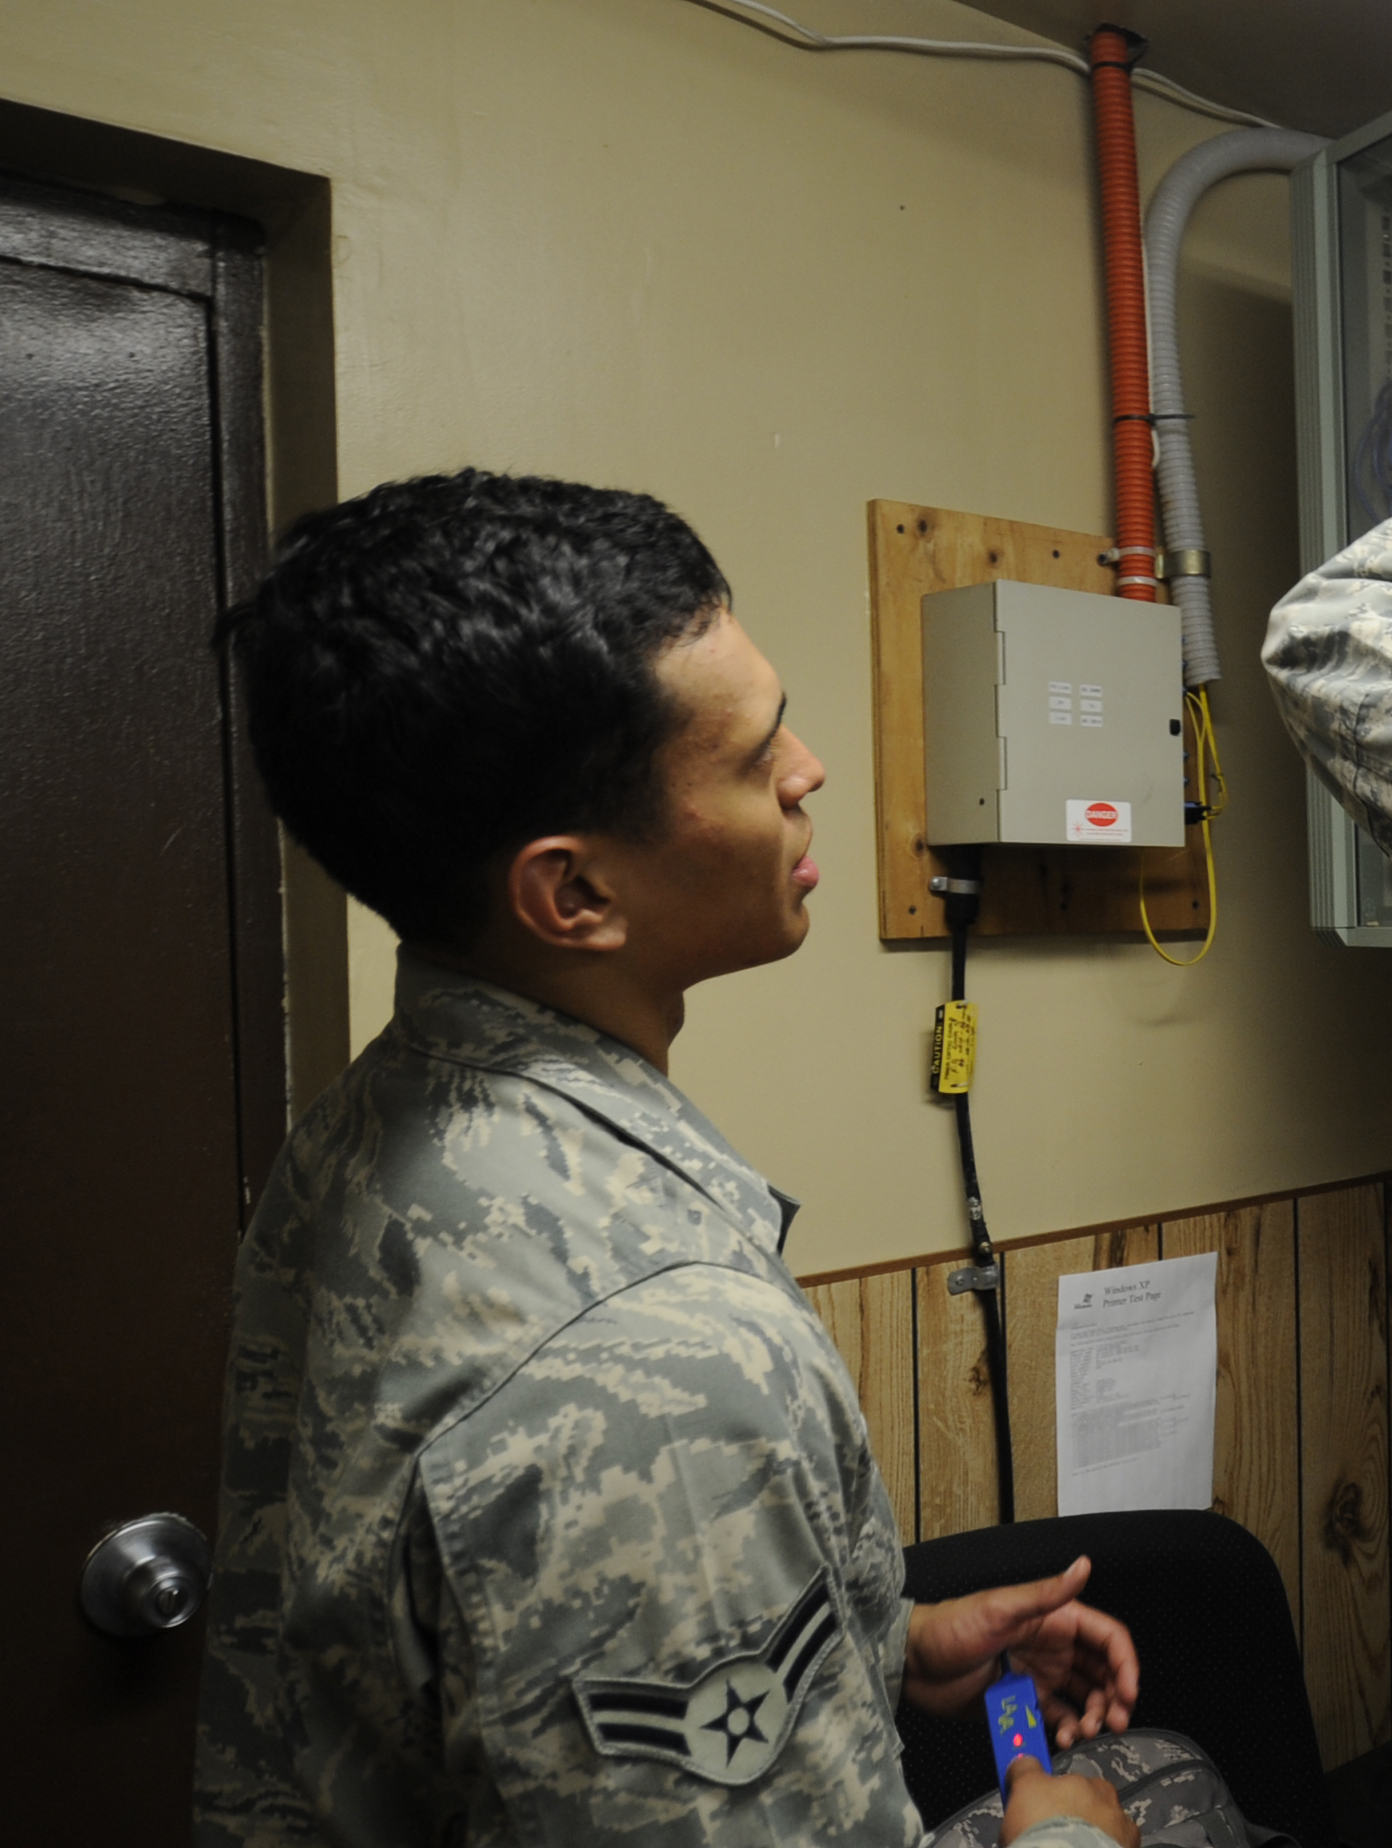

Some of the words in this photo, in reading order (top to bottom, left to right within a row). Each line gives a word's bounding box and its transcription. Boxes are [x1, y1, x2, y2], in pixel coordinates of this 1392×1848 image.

[932, 1026, 943, 1074] CAUTION
[1103, 1284, 1137, 1295] Windows
[1139, 1280, 1150, 1290] XP
[1103, 1298, 1127, 1308] Printer
[1129, 1294, 1144, 1304] Test
[1145, 1291, 1162, 1301] Page
